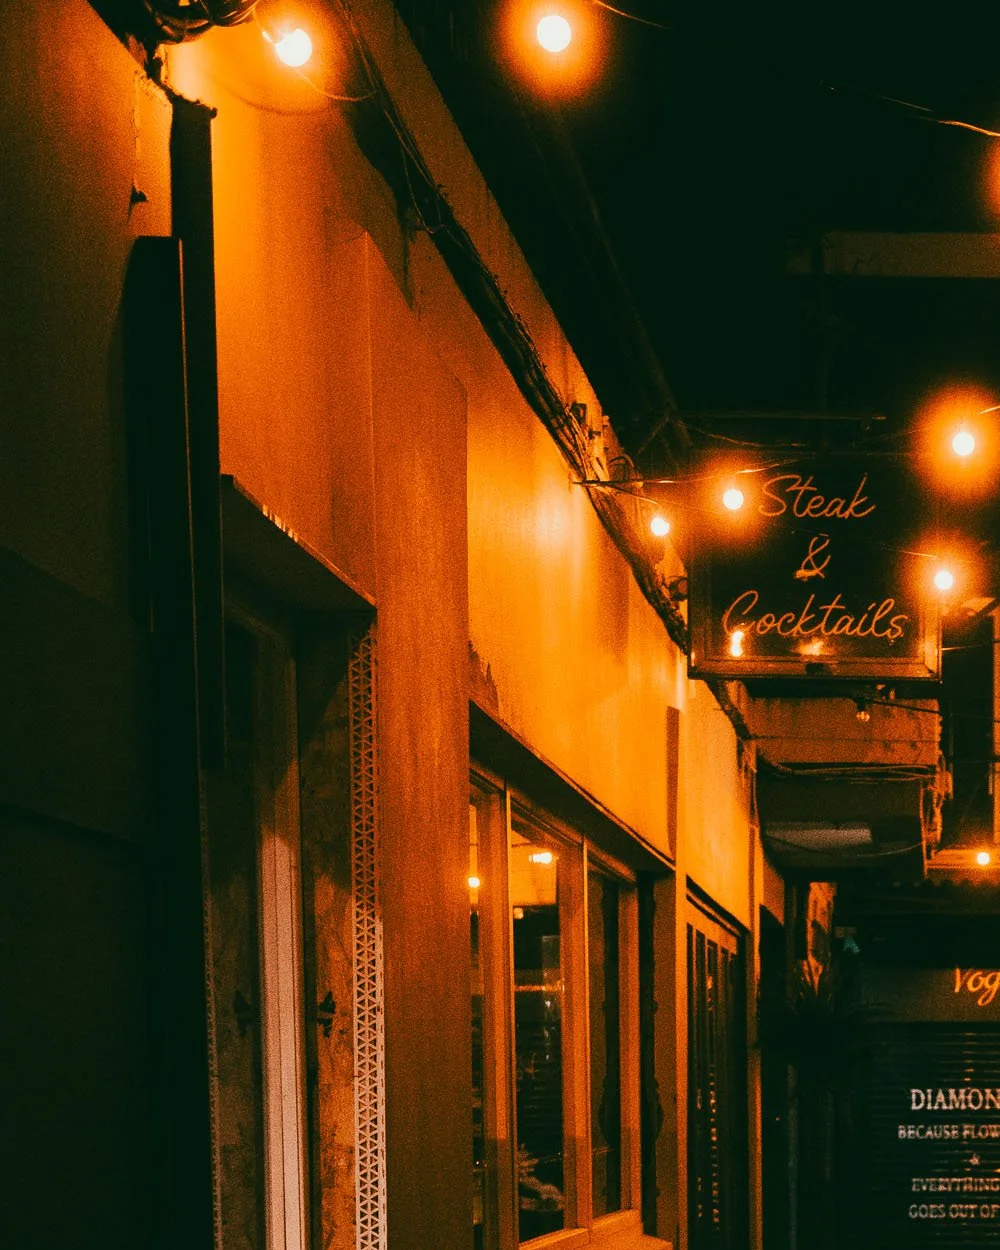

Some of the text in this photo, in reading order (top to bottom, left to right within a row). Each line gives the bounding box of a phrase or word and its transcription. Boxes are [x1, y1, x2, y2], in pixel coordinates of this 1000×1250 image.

[758, 473, 876, 519] Steak
[796, 533, 832, 580] &
[722, 590, 909, 639] Cocktails
[898, 1124, 959, 1139] BECAUSE
[911, 1176, 1000, 1193] EVERYTHING
[908, 1203, 946, 1219] GOES
[949, 1203, 978, 1219] OUT
[980, 1203, 998, 1219] OF
